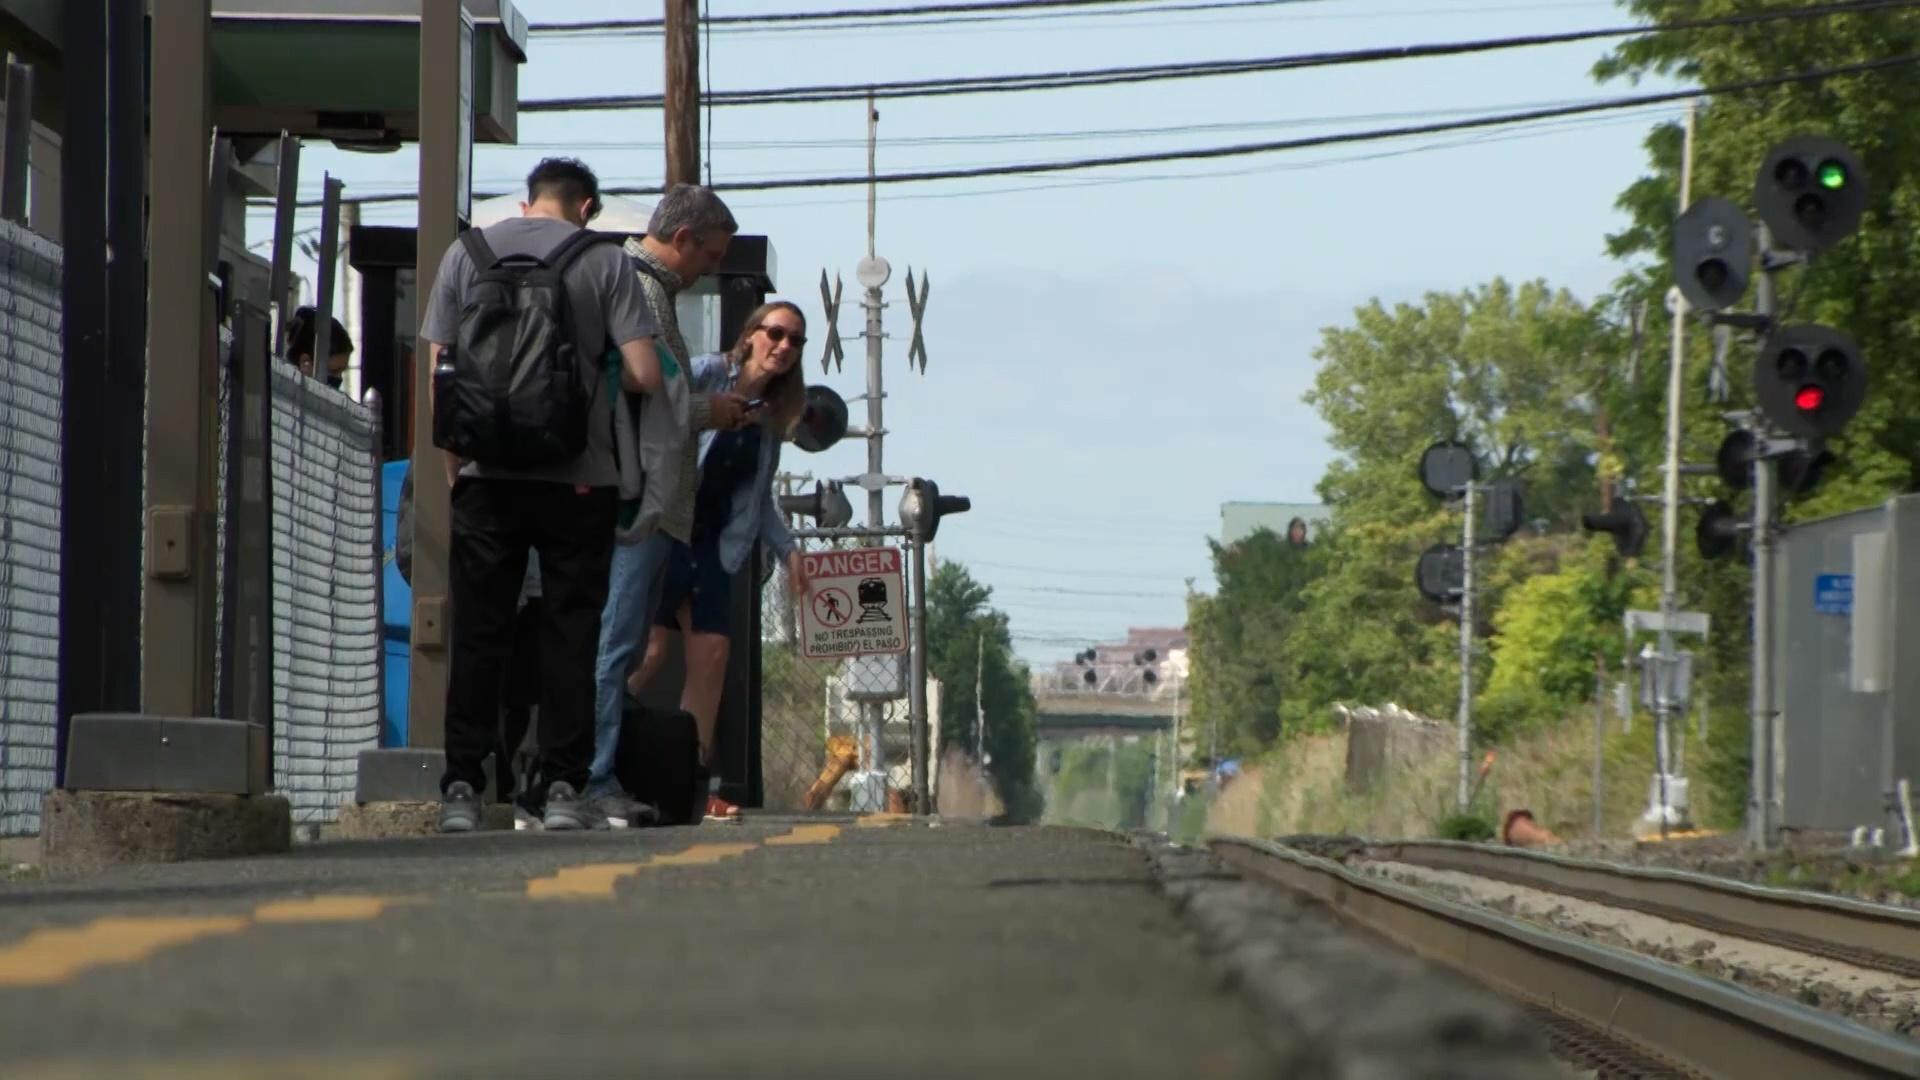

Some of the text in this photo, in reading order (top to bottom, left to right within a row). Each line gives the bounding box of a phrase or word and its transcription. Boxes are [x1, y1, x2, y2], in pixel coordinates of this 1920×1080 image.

[803, 551, 895, 577] DANGER
[814, 625, 893, 642] NO TRESPASSING
[863, 639, 875, 650] EL
[876, 637, 900, 649] PASO
